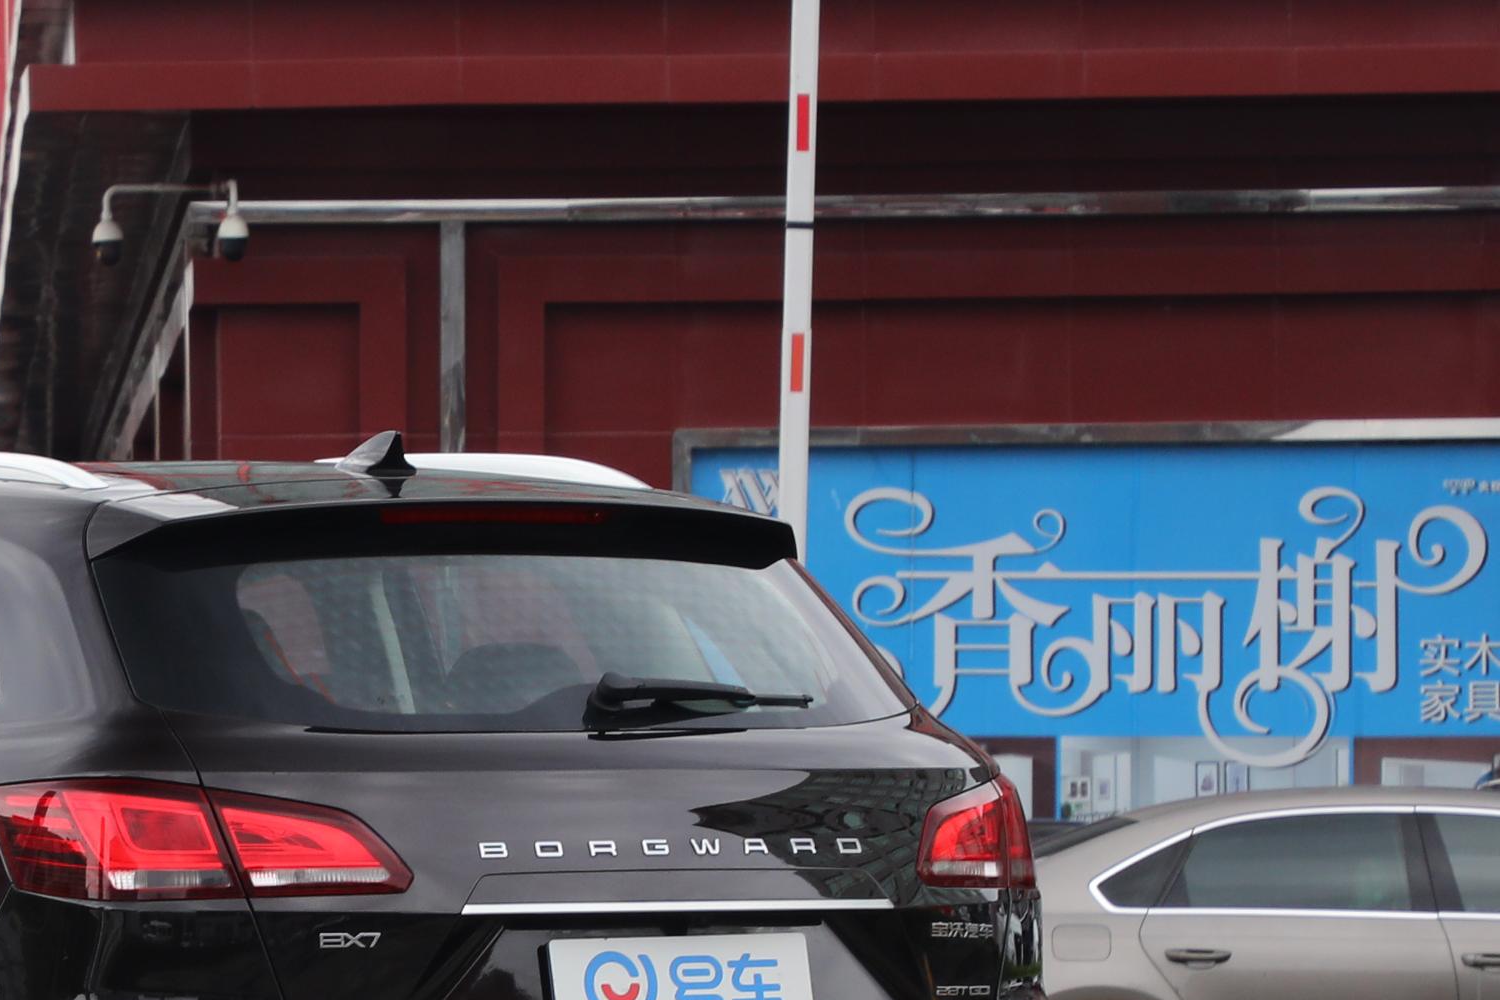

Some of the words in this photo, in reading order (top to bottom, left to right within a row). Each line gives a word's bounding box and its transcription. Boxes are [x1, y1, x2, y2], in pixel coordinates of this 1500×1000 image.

[844, 486, 1488, 730] 香丽榭
[1421, 634, 1500, 676] 实木
[1421, 680, 1500, 722] 家具
[479, 837, 863, 859] BORGWARD
[319, 932, 381, 948] BX7
[931, 921, 993, 939] 宝沃汽车
